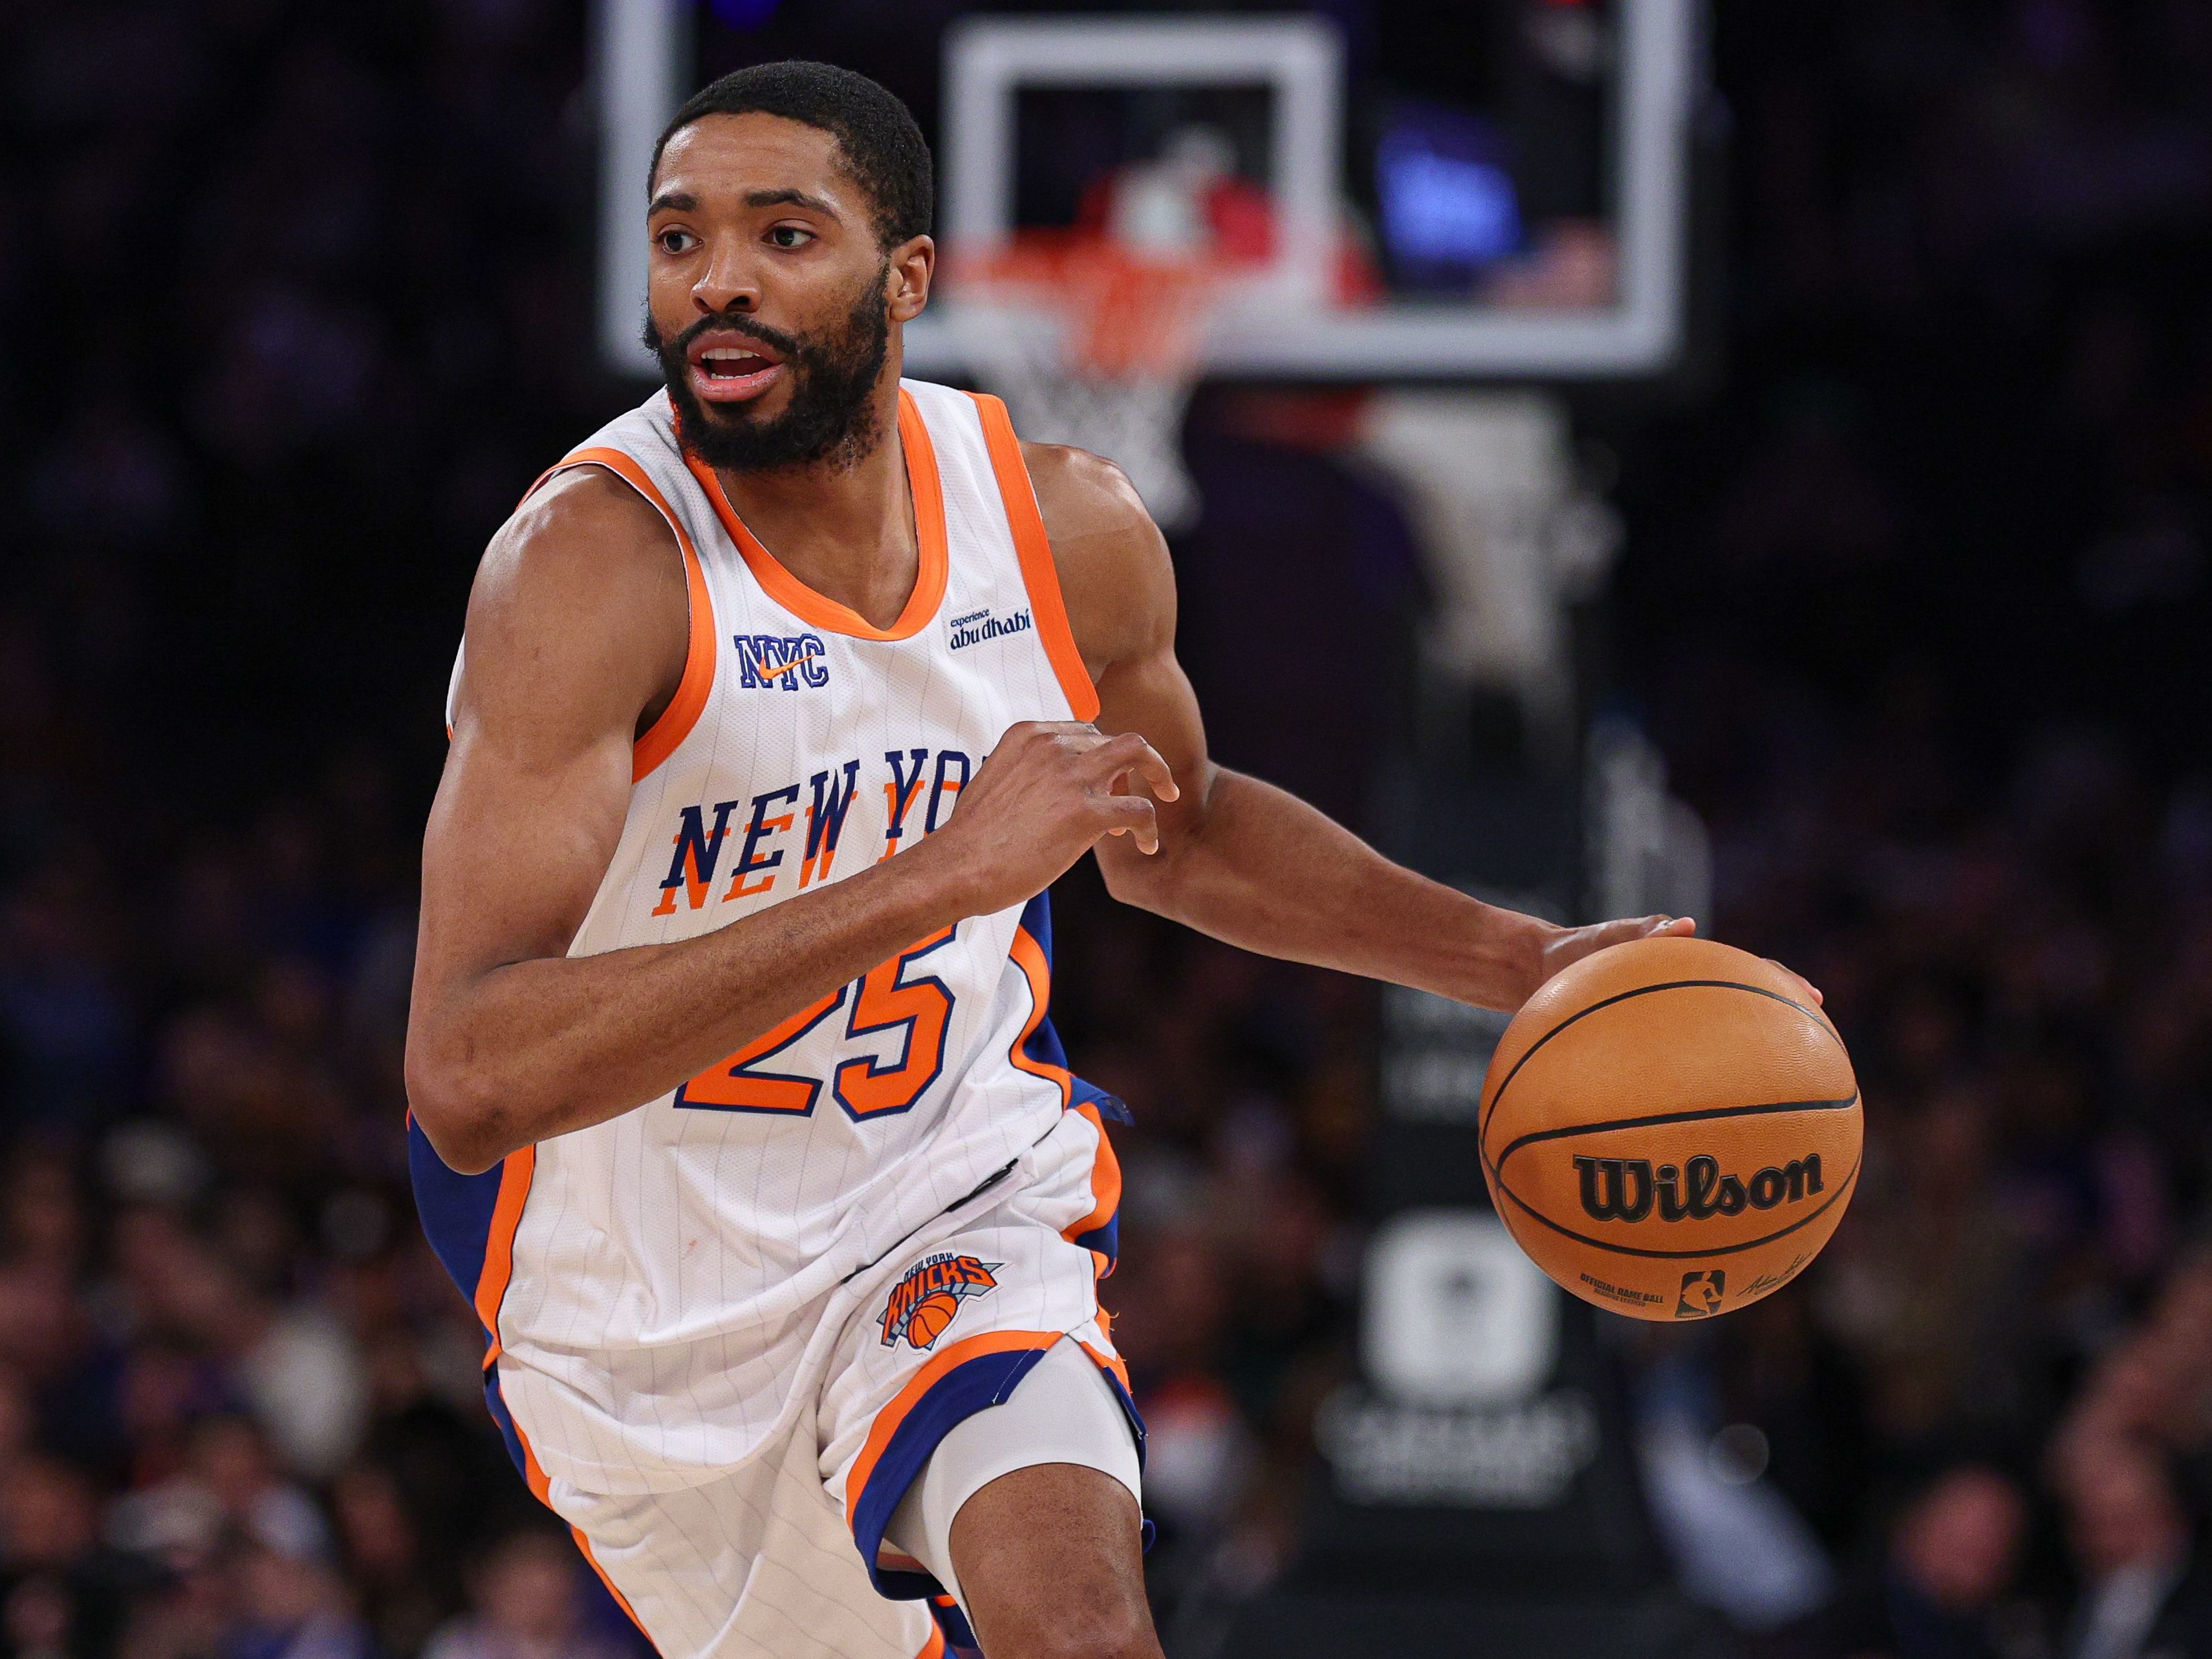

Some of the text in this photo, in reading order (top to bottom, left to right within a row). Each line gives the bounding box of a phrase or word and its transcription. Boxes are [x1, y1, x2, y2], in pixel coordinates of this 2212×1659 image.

[950, 608, 1031, 650] abu dhabi
[951, 609, 990, 627] experience
[733, 633, 829, 691] NYC
[658, 748, 988, 890] NEW YO
[673, 924, 957, 1123] 25
[1573, 1153, 1824, 1223] Wilson
[904, 1252, 955, 1282] NEW YORK
[1580, 1273, 1615, 1293] OFFICIAL
[1643, 1294, 1664, 1303] BALL
[881, 1255, 998, 1347] KNICKS
